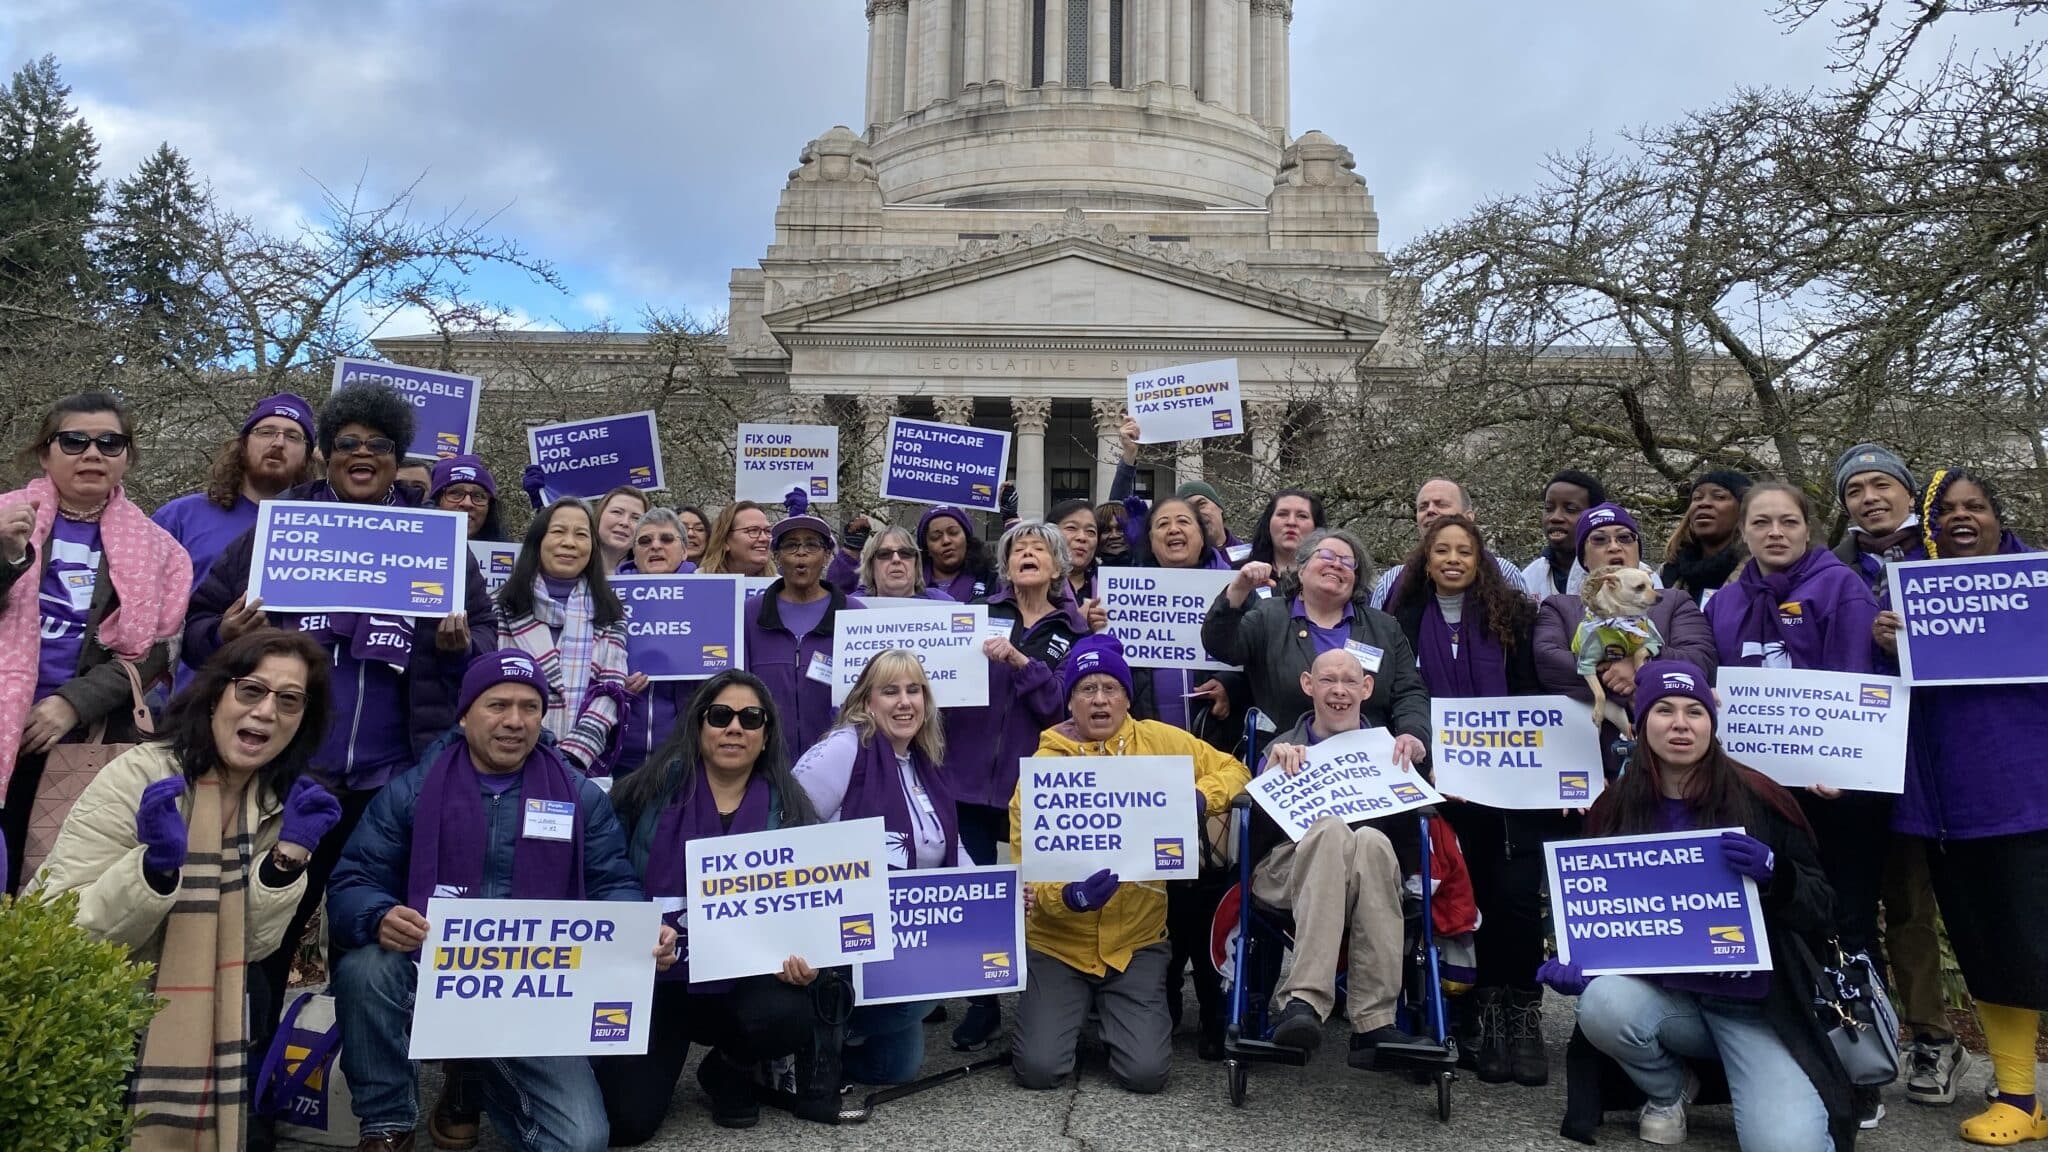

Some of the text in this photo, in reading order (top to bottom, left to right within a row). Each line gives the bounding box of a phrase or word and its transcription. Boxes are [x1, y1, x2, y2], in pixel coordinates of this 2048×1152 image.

[916, 357, 1076, 372] LEGISLATIVE
[344, 371, 465, 399] AFFORDABLE
[1135, 375, 1185, 391] FIX OUR
[1135, 381, 1229, 402] UPSIDE DOWN
[1135, 396, 1214, 414] TAX SYSTEM
[538, 427, 609, 447] WE CARE
[745, 434, 792, 444] FIX OUR
[896, 427, 984, 448] HEALTHCARE
[539, 446, 571, 461] FOR
[744, 447, 829, 458] UPSIDE DOWN
[895, 440, 922, 453] FOR
[540, 452, 619, 474] WACARES
[744, 461, 814, 471] TAX SYSTEM
[893, 454, 996, 477] NURSING HOME
[891, 468, 959, 486] WORKERS
[273, 513, 424, 533] HEALTHCARE
[271, 530, 319, 544] FOR
[269, 548, 448, 570] NURSING HOME
[267, 567, 387, 584] WORKERS
[1108, 578, 1156, 590] BUILD
[411, 596, 442, 605] SEIU 775
[611, 586, 684, 601] E CARE
[1107, 594, 1205, 609] POWER FOR
[1907, 593, 2029, 615] HOUSING
[1107, 609, 1206, 625] CAREGIVERS
[627, 621, 692, 636] CARES
[846, 625, 872, 635] WIN
[876, 622, 947, 634] UNIVERSAL
[1107, 627, 1175, 641] AND ALL
[1910, 616, 1986, 637] NOW!
[366, 632, 405, 648] SEIU
[844, 636, 973, 651] ACCESS TO QUALITY
[1121, 645, 1196, 660] ORKERS
[844, 657, 869, 667] HEA
[926, 670, 957, 680] CARE
[1729, 685, 1854, 702] WIN UNIVERSAL
[1443, 710, 1563, 728] FIGHT FOR
[1727, 704, 1887, 723] ACCESS TO QUALITY
[1727, 722, 1824, 737] HEALTH AND
[1443, 730, 1537, 748] JUSTICE
[1444, 748, 1542, 768] FOR ALL
[1727, 741, 1863, 759] LONG-TERM CARE
[1033, 771, 1096, 789] MAKE
[1269, 751, 1370, 802] POWER FOR
[1278, 765, 1382, 810] CAREGIVERS
[1033, 791, 1167, 809] CAREGIVING
[1288, 784, 1363, 820] AND ALL
[1034, 813, 1122, 830] A GOOD
[1295, 796, 1393, 830] WORKERS
[1034, 834, 1122, 851] CAREER
[701, 847, 794, 874] FIX OUR
[1560, 847, 1705, 873] HEALTHCARE
[702, 861, 870, 897] UPSIDE DOWN
[1563, 876, 1608, 894] FOR
[888, 882, 1007, 906] FFORDABLE
[702, 888, 843, 921] TAX SYSTEM
[1566, 892, 1742, 917] NURSING HOME
[890, 906, 963, 927] OUSING
[442, 918, 616, 943] FIGHT FOR
[1569, 918, 1684, 940] WORKERS
[844, 938, 872, 948] SEIU 775
[892, 930, 928, 949] OW!
[437, 946, 572, 971] JUSTICE
[1713, 945, 1746, 955] SEIU 775
[984, 970, 1010, 979] SEIU 775
[435, 974, 573, 999] FOR ALL
[594, 1028, 626, 1037] SEIU 775
[295, 1095, 320, 1116] 775
